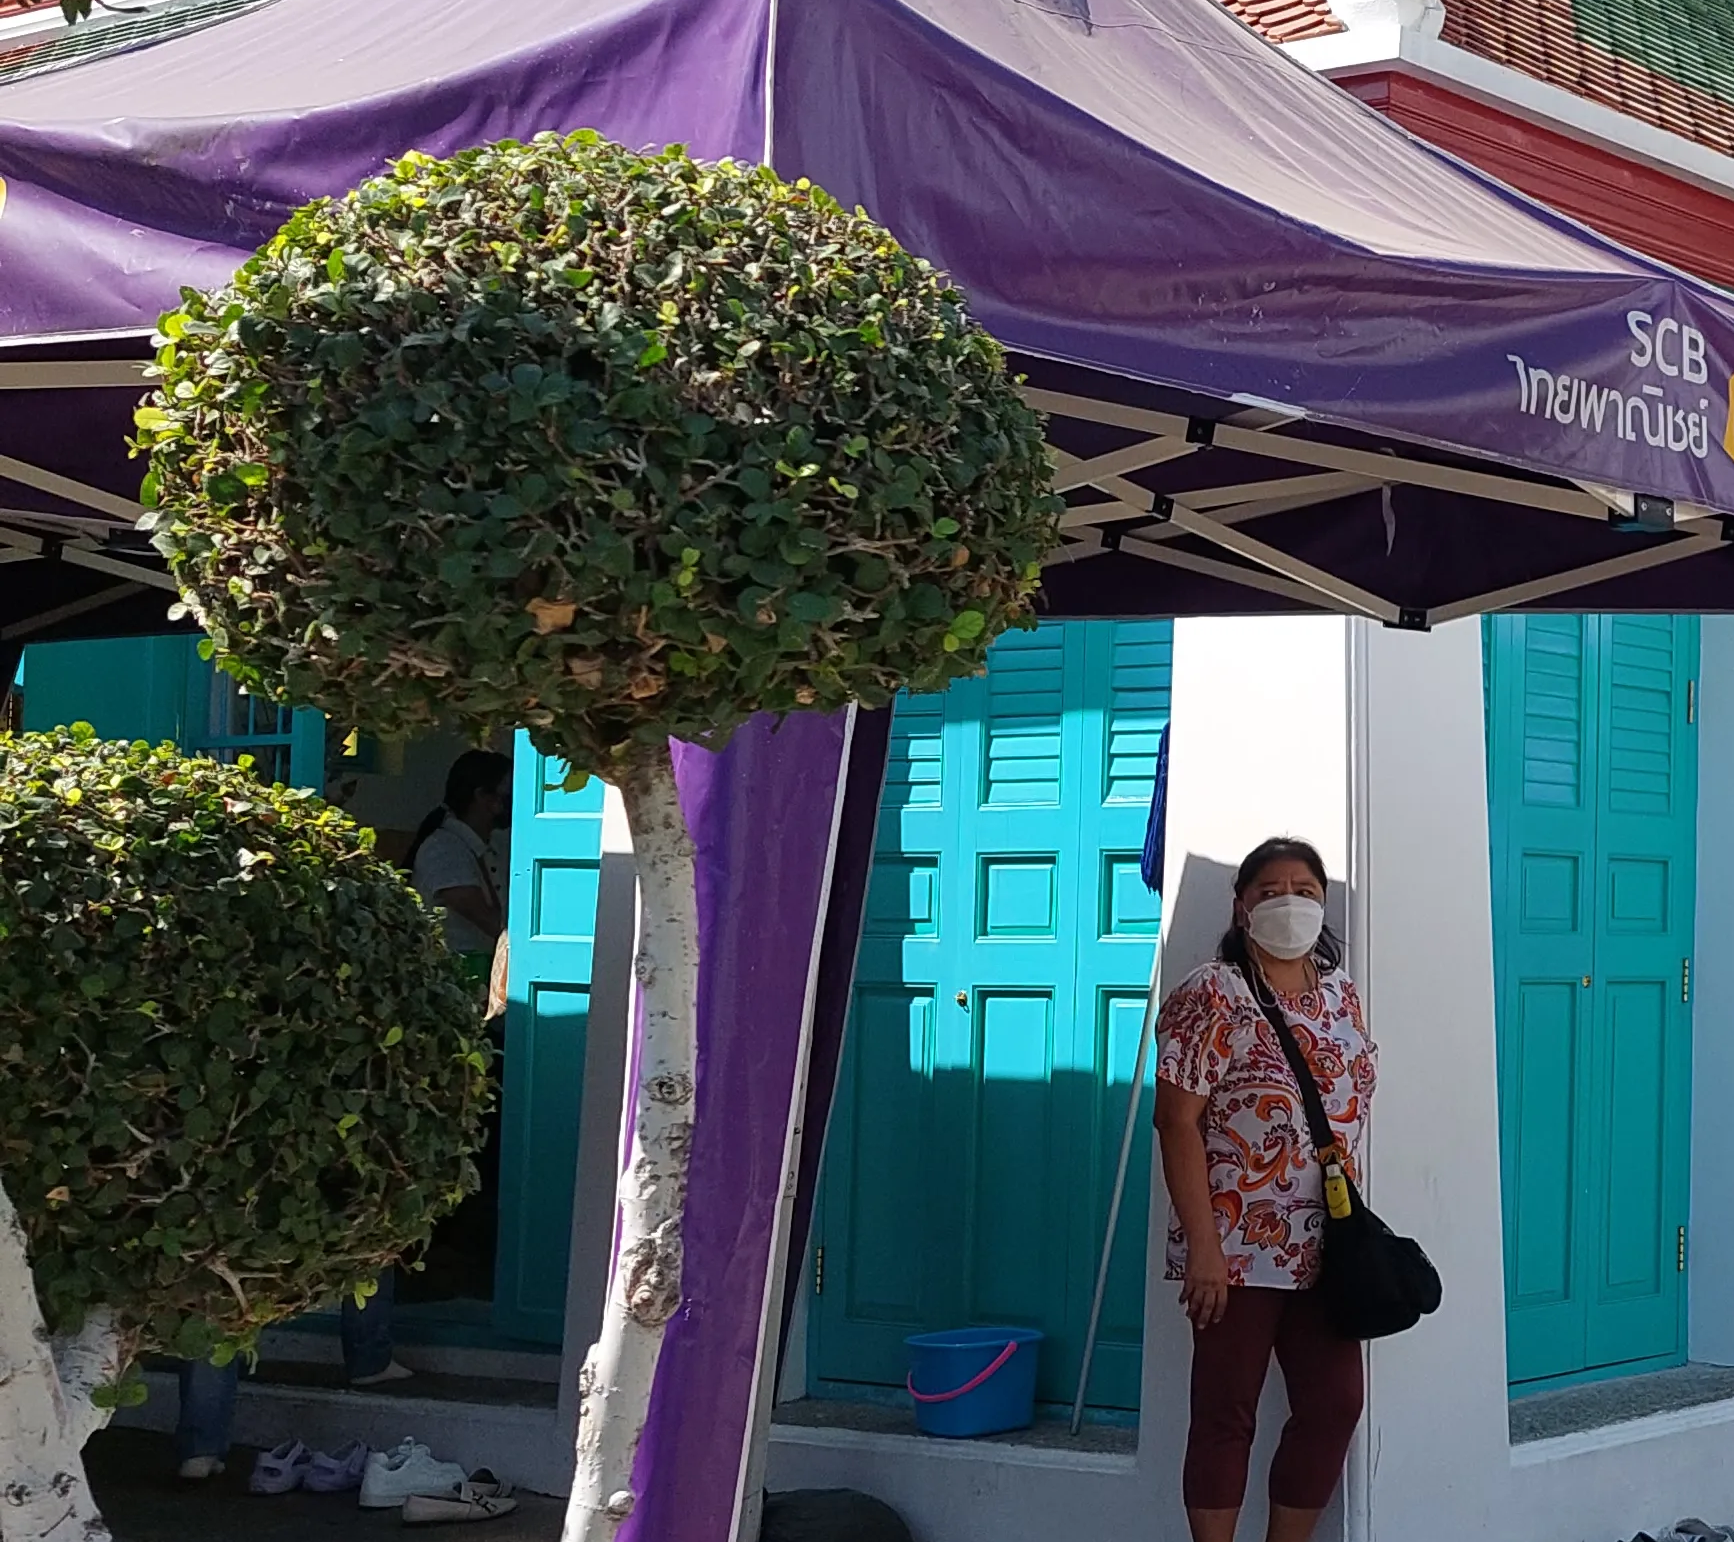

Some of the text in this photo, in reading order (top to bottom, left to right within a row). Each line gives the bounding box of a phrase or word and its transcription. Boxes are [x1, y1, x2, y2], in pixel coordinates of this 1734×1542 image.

[1626, 310, 1709, 385] SCB
[1506, 354, 1709, 459] ไทยพาณิชย์
